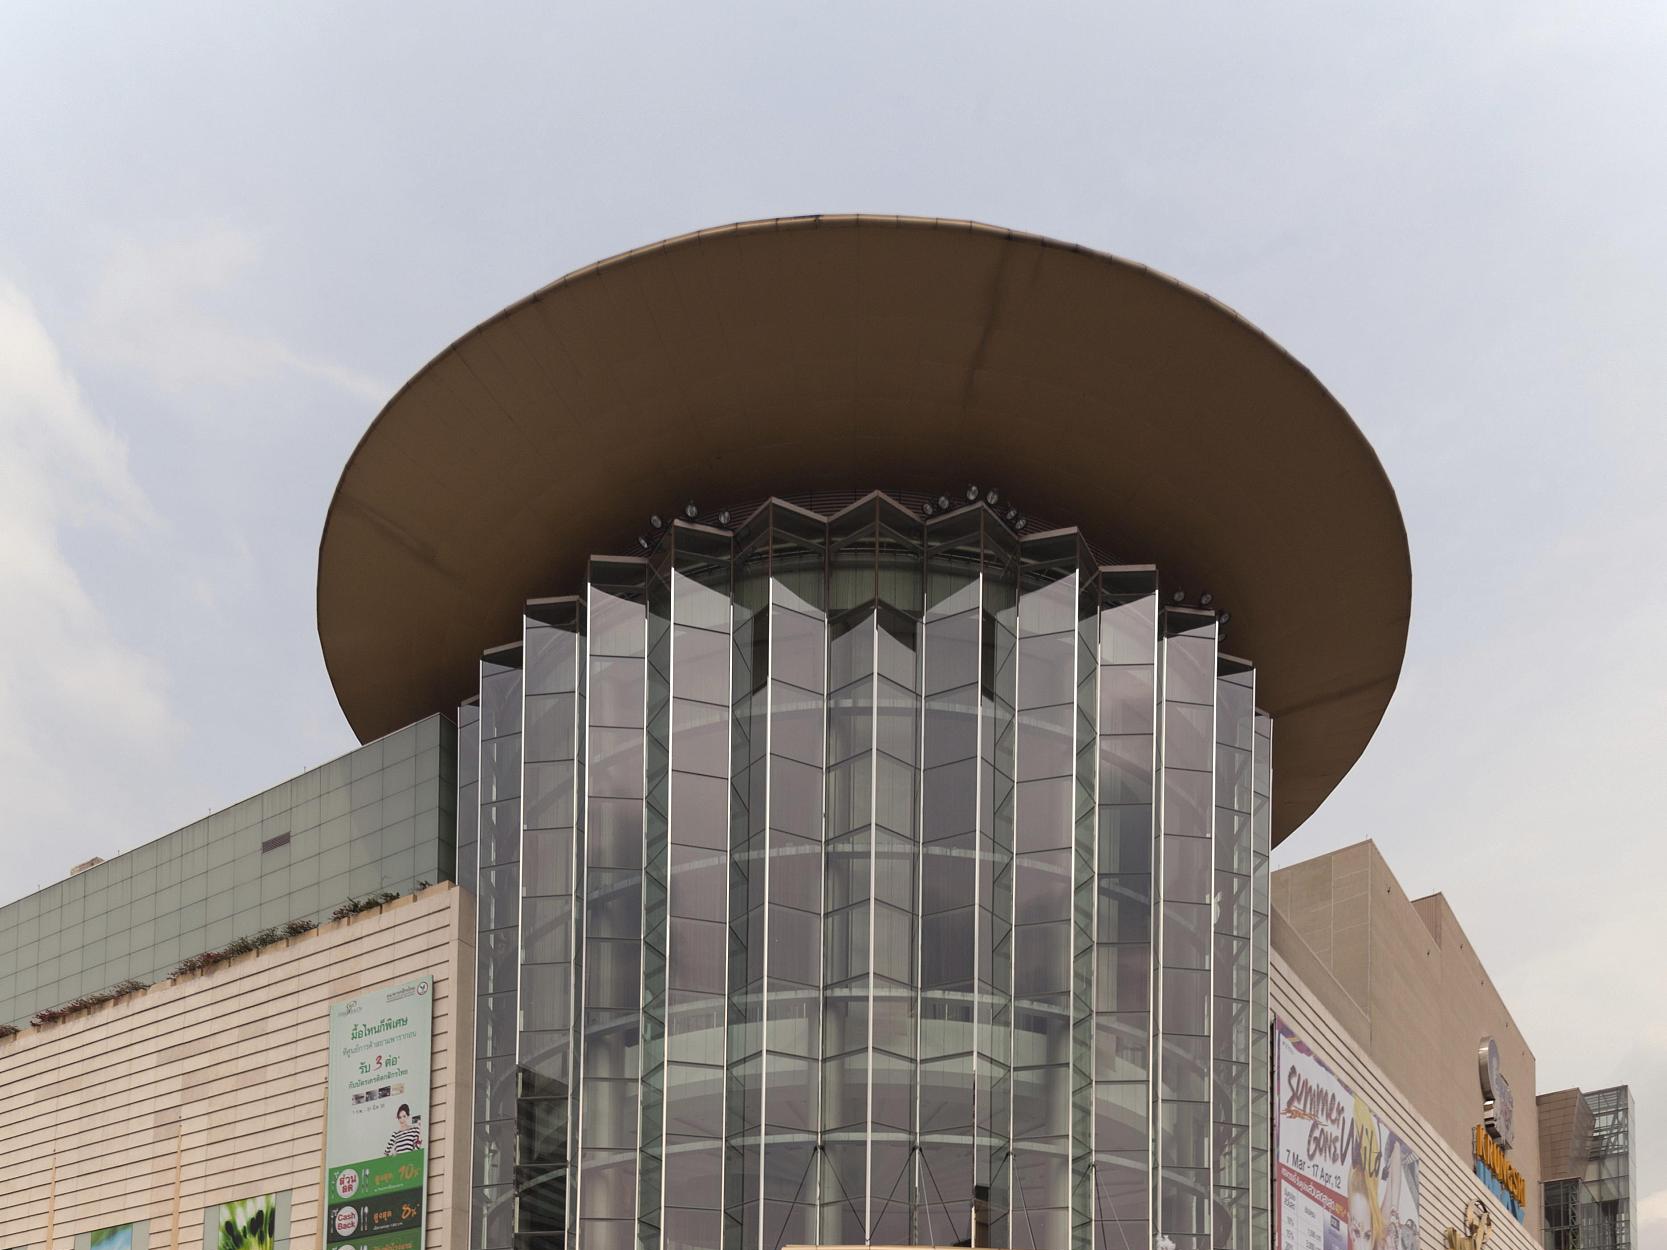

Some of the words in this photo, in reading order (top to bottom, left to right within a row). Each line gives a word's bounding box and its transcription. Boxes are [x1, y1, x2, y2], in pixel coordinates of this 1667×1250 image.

[351, 1016, 408, 1040] มื้อไหนก็พิเศษ
[374, 1055, 383, 1071] 3
[1292, 1152, 1306, 1171] Mar
[1312, 1164, 1319, 1177] 17
[337, 1213, 356, 1222] Cash
[337, 1221, 356, 1231] Back
